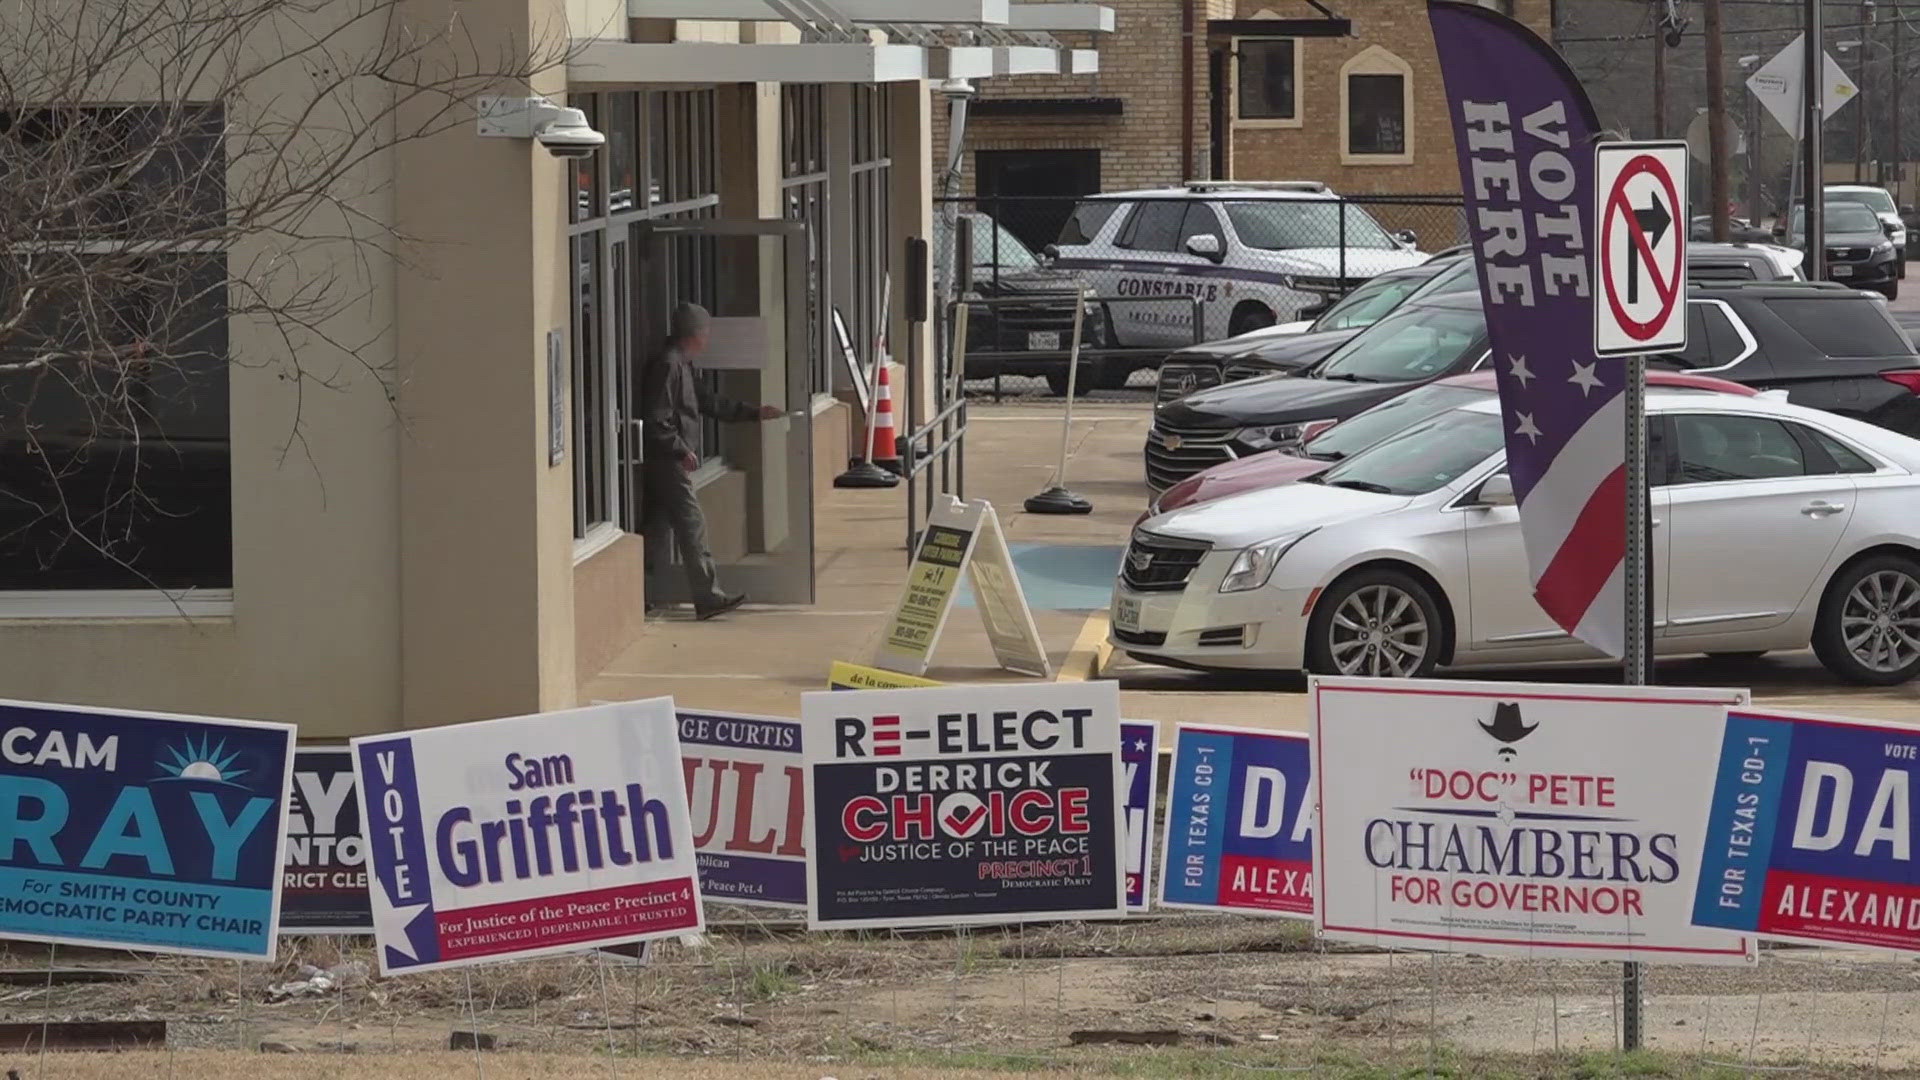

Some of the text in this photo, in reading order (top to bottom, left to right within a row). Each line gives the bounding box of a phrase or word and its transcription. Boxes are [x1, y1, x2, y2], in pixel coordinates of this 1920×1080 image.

[1462, 100, 1535, 306] HERE
[1522, 100, 1590, 297] VOTE
[1117, 277, 1218, 302] CONSTABLE
[1, 727, 119, 772] CAM
[715, 721, 795, 747] CURTIS
[834, 708, 1093, 758] RE-ELECT
[1884, 743, 1917, 759] VOTE
[505, 752, 575, 791] Sam
[875, 760, 1052, 793] DERRICK
[1529, 774, 1615, 807] PETE
[0, 774, 275, 881] RAY
[376, 751, 413, 899] VOTE
[842, 787, 1090, 842] CHOICE
[1185, 747, 1215, 887] FOR TEXAS CD-1
[1719, 737, 1769, 908] FOR TEXAS CD-1
[1792, 760, 1911, 861] DA
[435, 783, 675, 888] Griffith
[860, 843, 944, 862] JUSTICE
[948, 841, 974, 858] OF
[982, 840, 1021, 857] THE
[1025, 837, 1089, 855] PEACE
[1365, 819, 1680, 883] CHAMBERS
[708, 879, 736, 893] Peace
[978, 855, 1092, 880] PRECINCT 1
[23, 879, 221, 910] For SMITH COUNTY
[439, 887, 691, 935] For Justice of the Peace Precinct 4
[1391, 875, 1644, 916] FOR GOVERNOR
[123, 909, 191, 929] PARTY
[197, 915, 262, 936] CHAIR
[447, 907, 687, 949] EXPERIENCED DEPENDABLE TRUSTED
